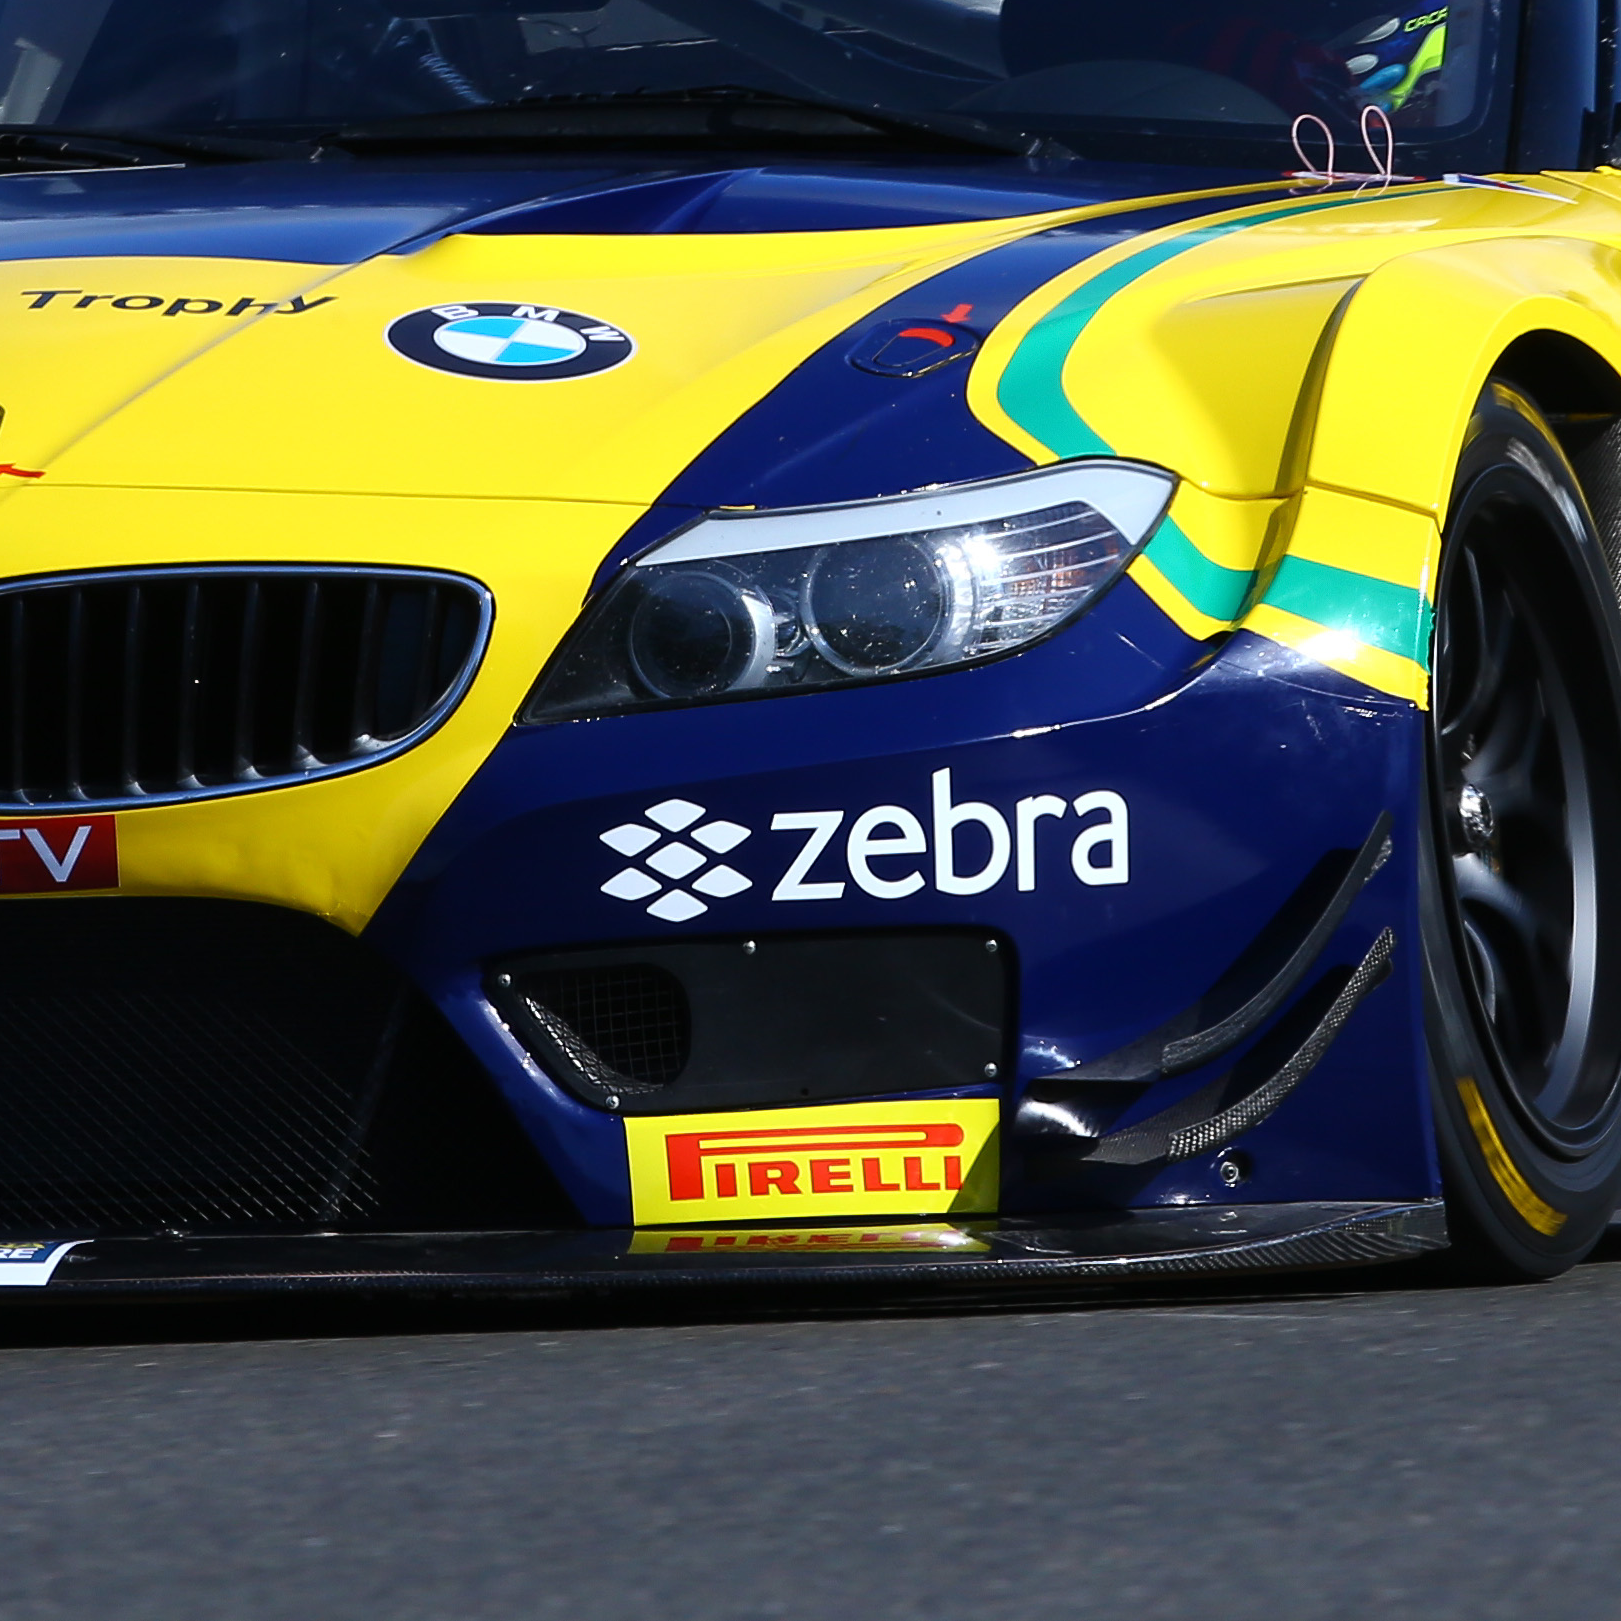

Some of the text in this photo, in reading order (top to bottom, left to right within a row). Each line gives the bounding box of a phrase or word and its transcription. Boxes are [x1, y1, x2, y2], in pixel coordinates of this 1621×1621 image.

[21, 289, 338, 317] Trophy
[430, 304, 626, 342] BMW
[770, 767, 1130, 901] zebra
[665, 1122, 965, 1202] PIRELLI
